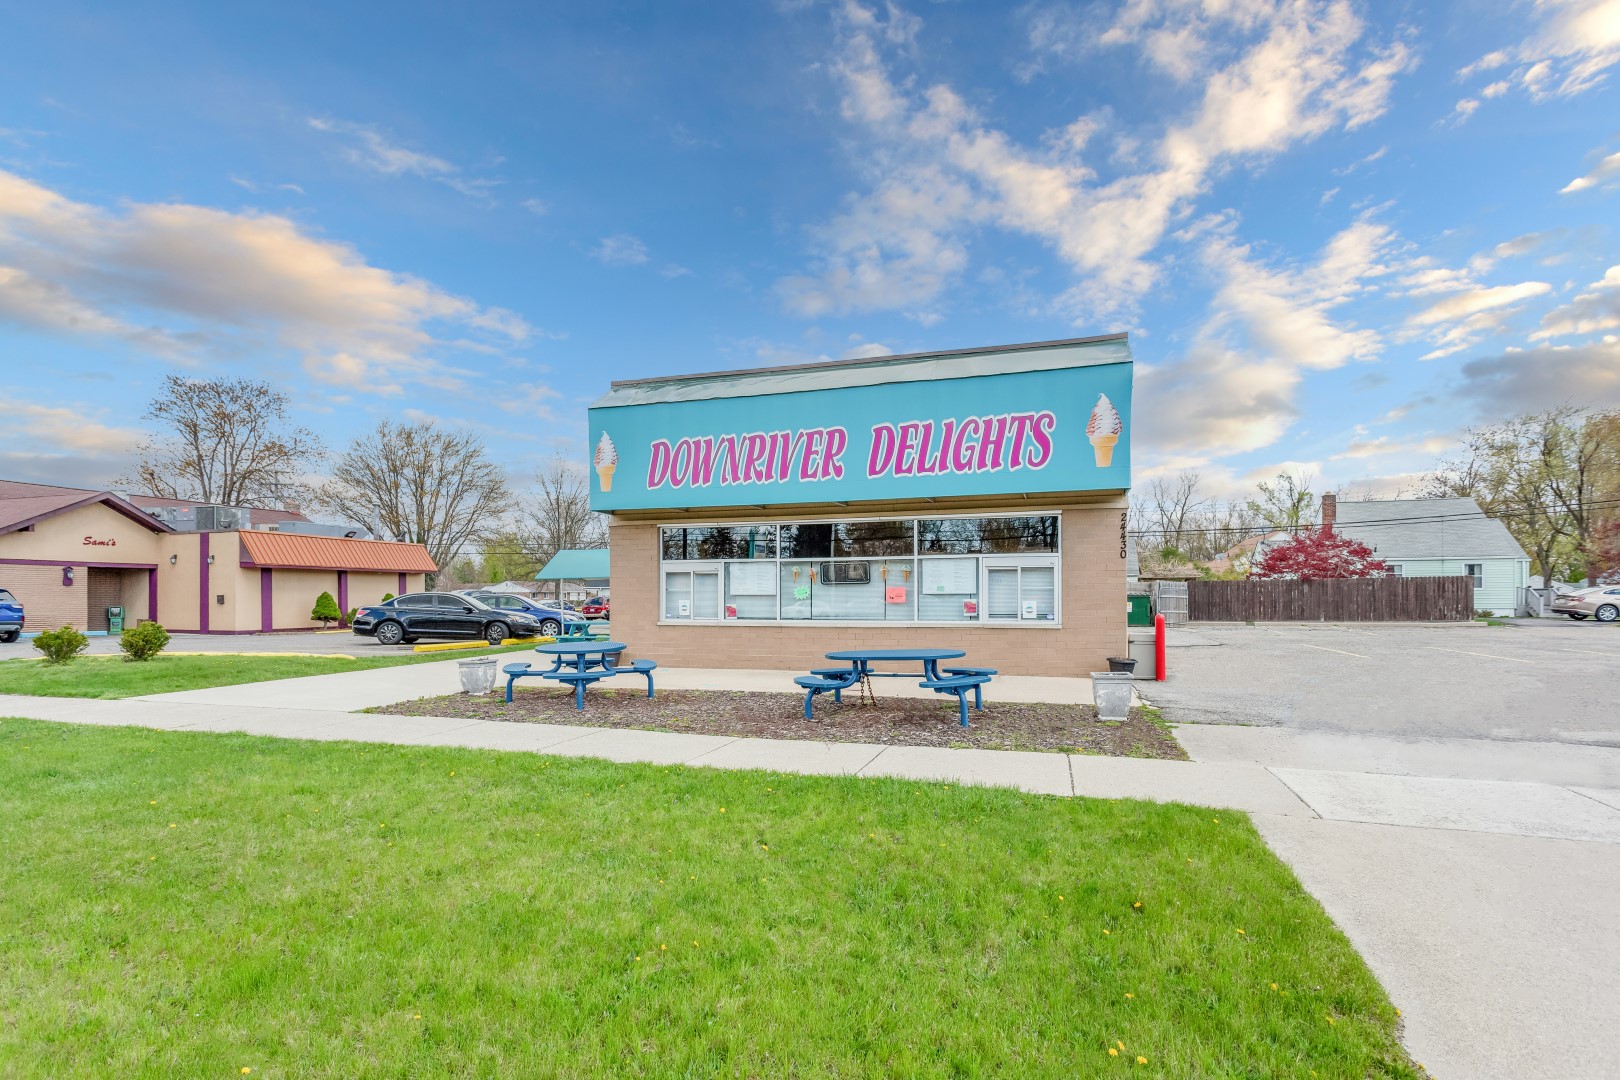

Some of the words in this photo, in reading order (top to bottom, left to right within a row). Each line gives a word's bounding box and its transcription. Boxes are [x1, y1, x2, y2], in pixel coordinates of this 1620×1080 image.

[647, 426, 848, 490] DOWNRIVER
[867, 410, 1056, 478] DELIGHTS
[82, 536, 116, 547] Sami's
[1119, 512, 1127, 559] 24430
